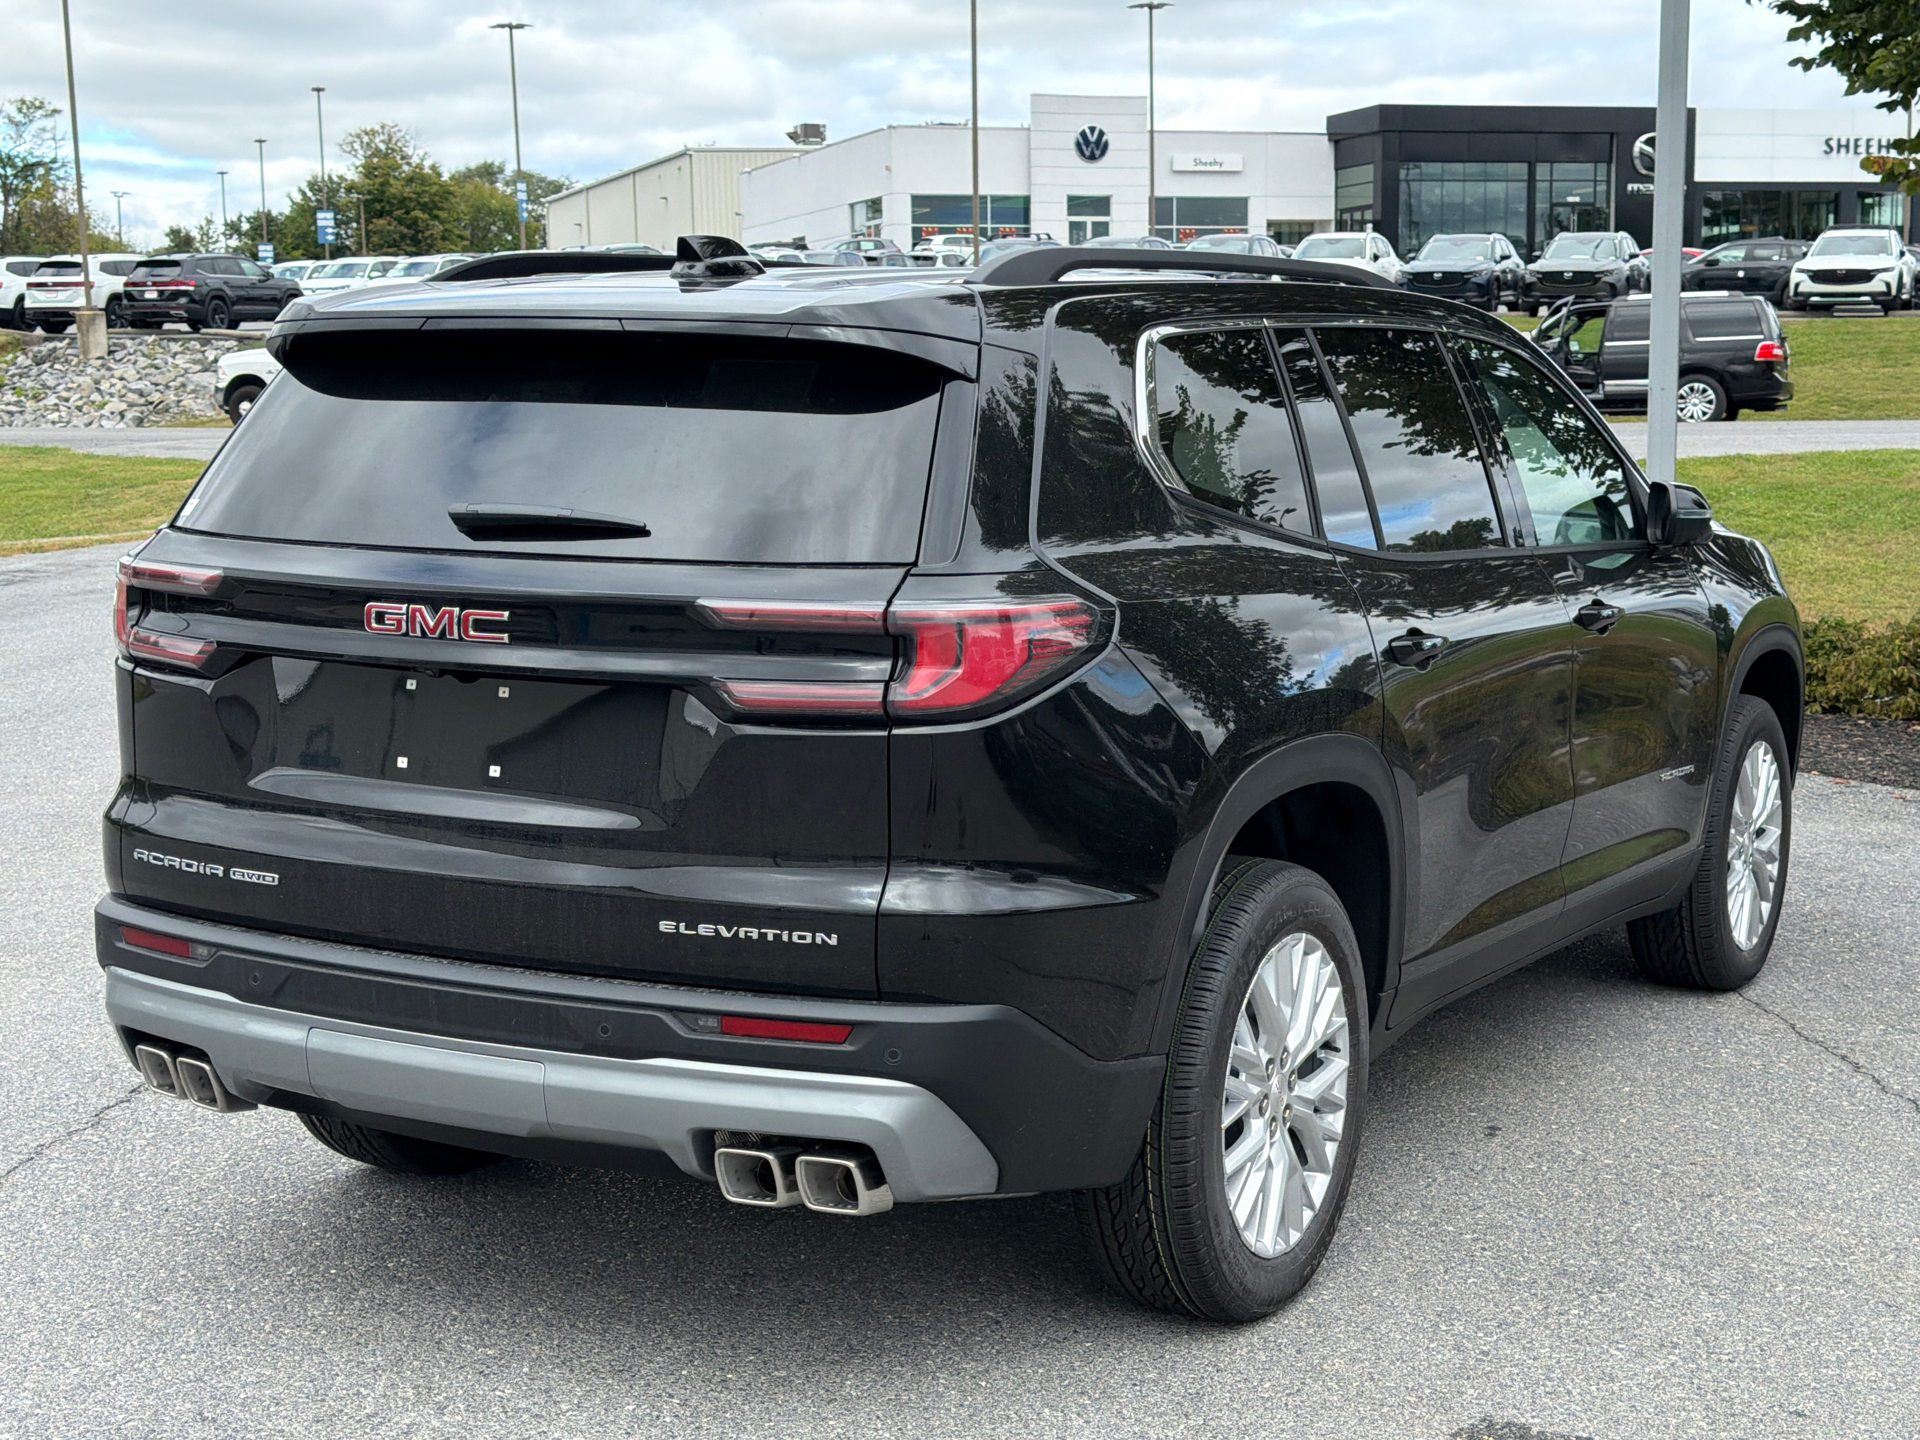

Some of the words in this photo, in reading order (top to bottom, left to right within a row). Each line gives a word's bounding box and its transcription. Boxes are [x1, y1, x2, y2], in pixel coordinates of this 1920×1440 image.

[1823, 137, 1892, 155] SHEEH
[1193, 157, 1224, 169] Sheehy
[364, 602, 511, 644] GMC
[133, 848, 225, 878] ACADIA
[230, 868, 280, 886] AWD
[658, 920, 838, 946] ELEVATION
